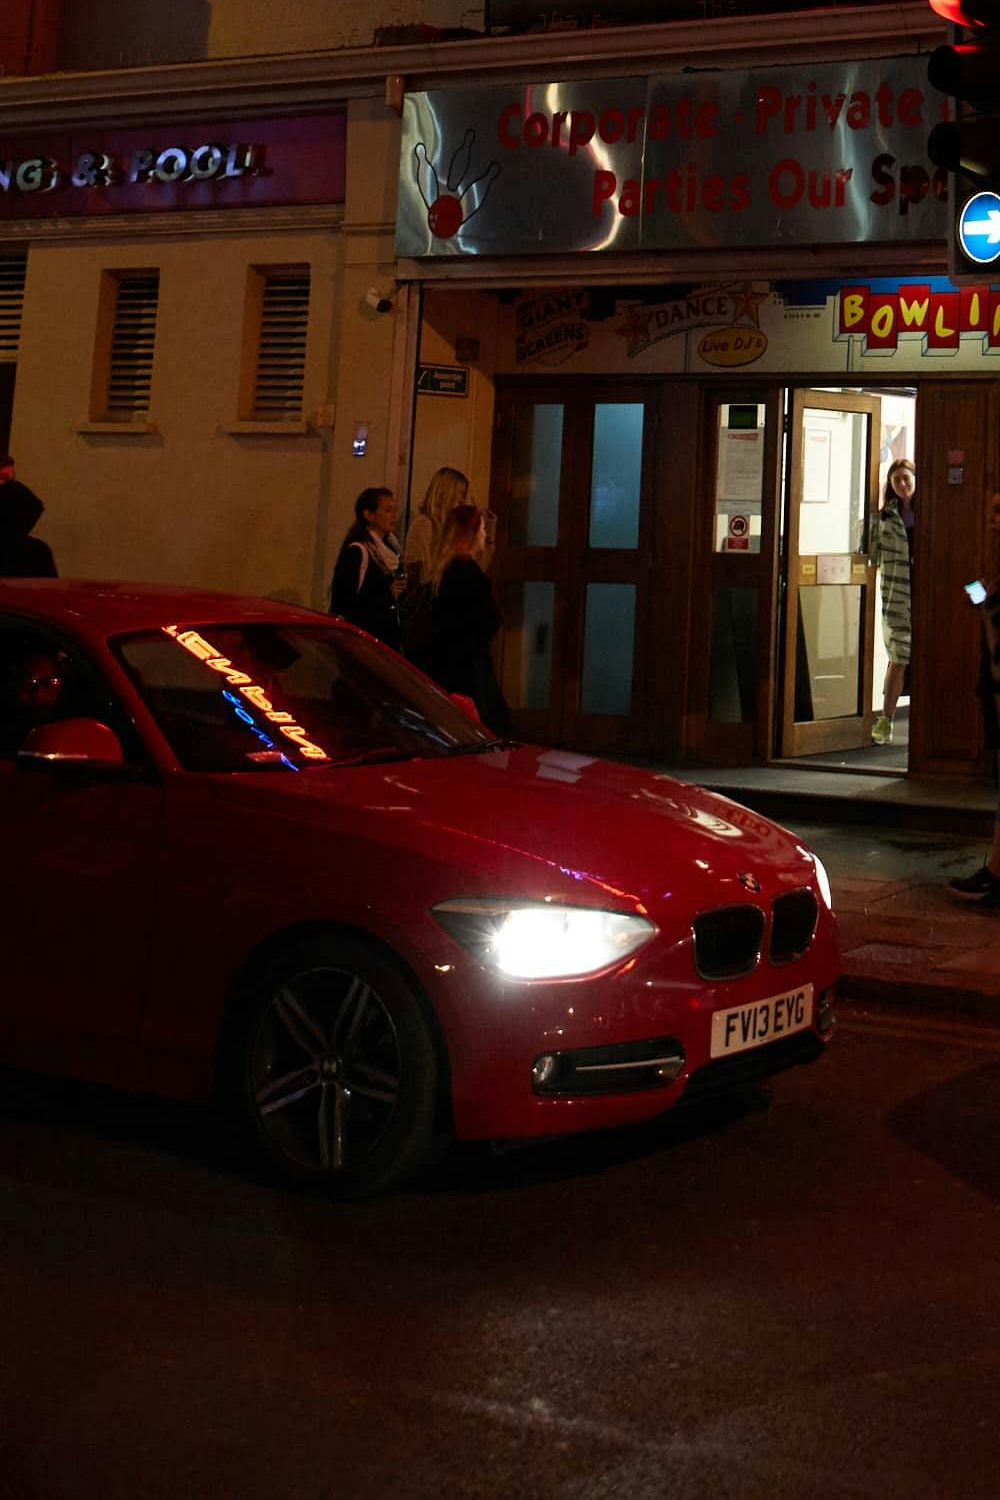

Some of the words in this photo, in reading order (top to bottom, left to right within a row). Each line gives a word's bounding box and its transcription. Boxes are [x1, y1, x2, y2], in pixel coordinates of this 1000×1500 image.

[499, 94, 720, 156] Corporate
[754, 82, 925, 134] Private
[130, 144, 245, 184] POOL
[592, 162, 751, 217] Parties
[768, 157, 853, 209] Our
[656, 295, 728, 328] DANCE
[725, 1005, 770, 1047] FV13
[773, 993, 805, 1033] EYG
